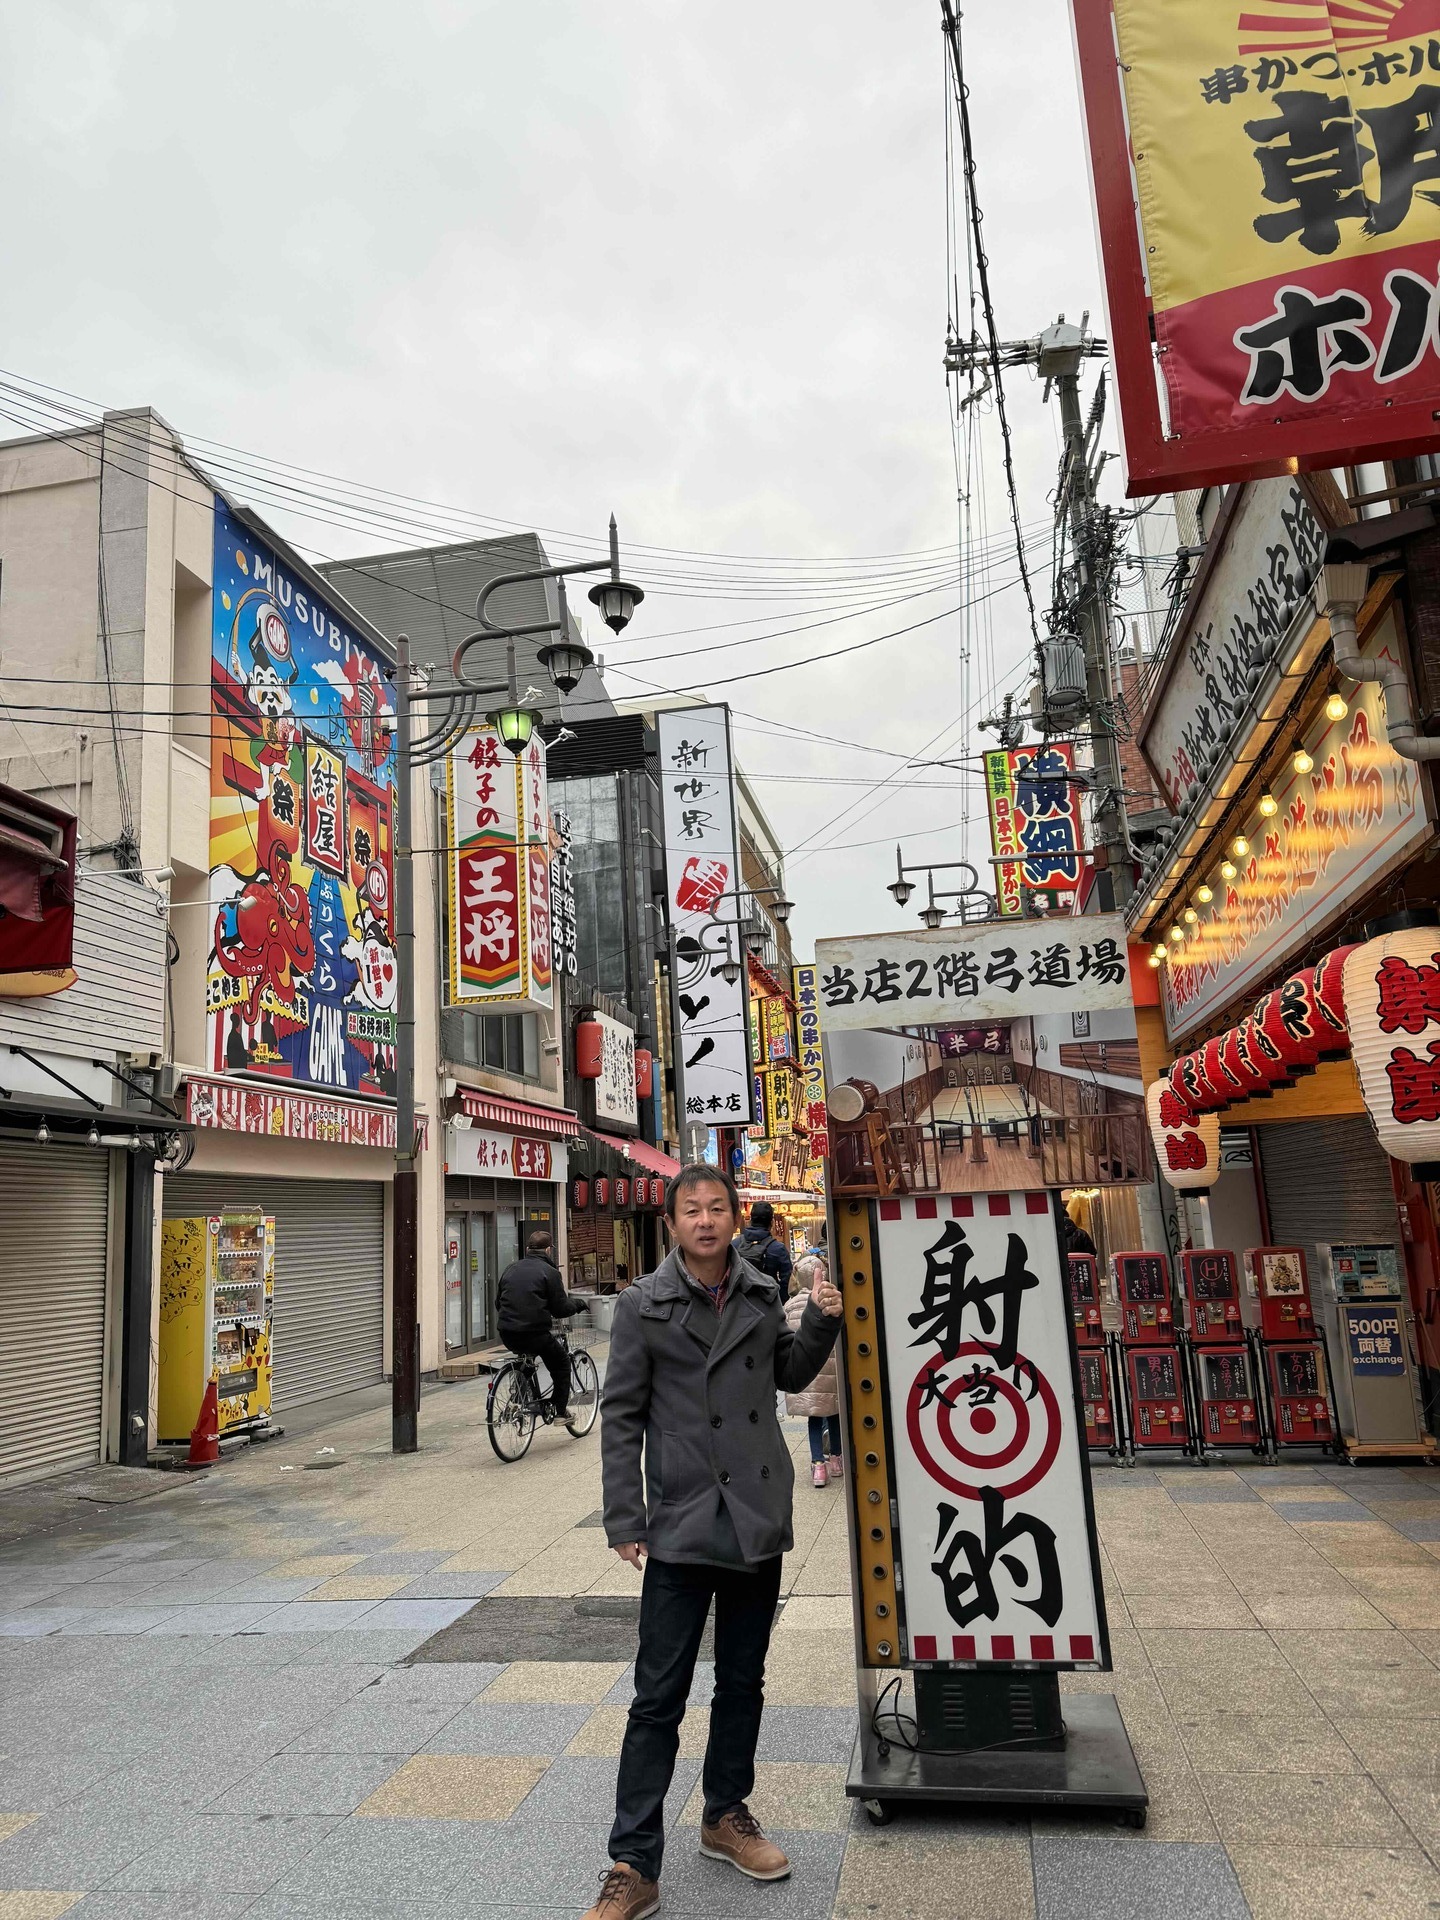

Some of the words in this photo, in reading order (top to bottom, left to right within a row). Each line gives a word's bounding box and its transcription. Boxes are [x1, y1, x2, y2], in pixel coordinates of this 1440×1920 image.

[253, 553, 382, 690] MUSUBIYA
[268, 617, 288, 656] GAME
[1188, 620, 1215, 678] 日本一
[270, 774, 295, 829] 祭
[671, 739, 720, 841] 新世界
[989, 754, 1008, 795] 新世界
[310, 750, 340, 861] 結屋
[1011, 751, 1078, 885] 横綱
[463, 737, 517, 964] 餃子の王将
[994, 797, 1021, 913] 日本一の串かつ
[369, 871, 386, 900] UFO
[318, 880, 338, 992] ぷりくら
[369, 946, 384, 1000] 新世界
[819, 937, 1127, 1008] 当店2階弓道場
[308, 1002, 348, 1088] GAME
[798, 969, 823, 1083] 日本一の串かつ
[686, 1093, 743, 1115] 総本店
[773, 1073, 789, 1121] 射的
[476, 1137, 546, 1177] 餃子の王将
[806, 1101, 829, 1161] 横綱
[1349, 1318, 1400, 1335] 500円
[1357, 1337, 1393, 1354] 両替
[915, 1357, 1040, 1410] 大当り
[1352, 1355, 1404, 1365] exchange
[906, 1219, 1064, 1629] 射的
